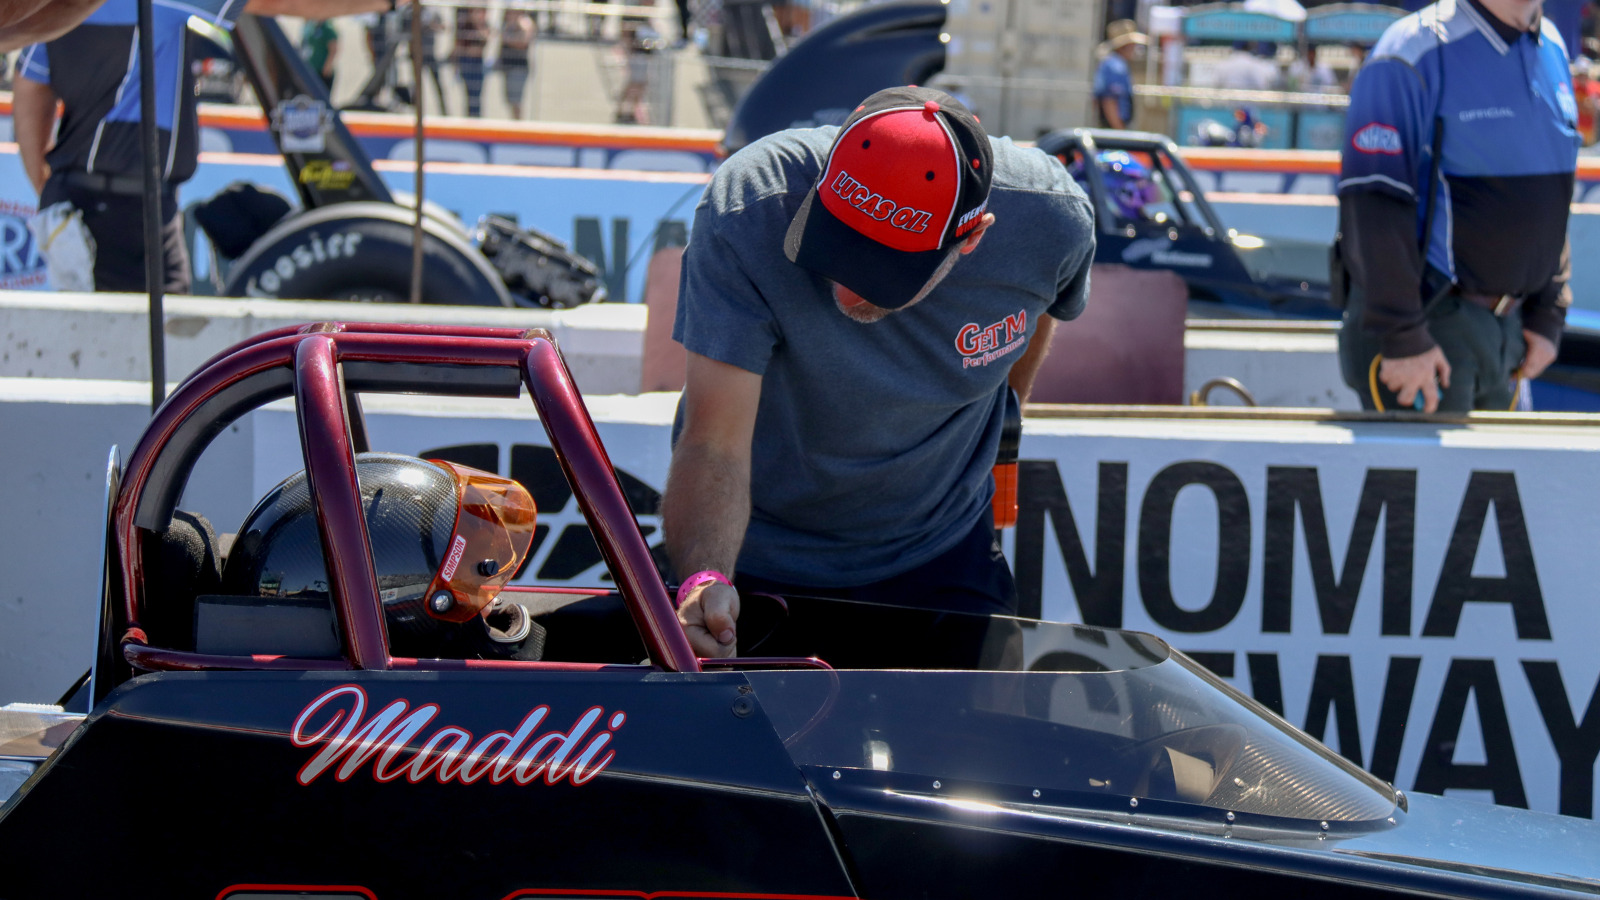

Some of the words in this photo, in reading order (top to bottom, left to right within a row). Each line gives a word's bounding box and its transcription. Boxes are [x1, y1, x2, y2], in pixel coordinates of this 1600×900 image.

[1356, 126, 1402, 151] NHRA
[831, 170, 897, 221] LUCAS
[890, 207, 933, 233] OIL
[963, 335, 1026, 369] Performance
[443, 537, 466, 580] SIMPSON
[290, 683, 627, 787] Maddi
